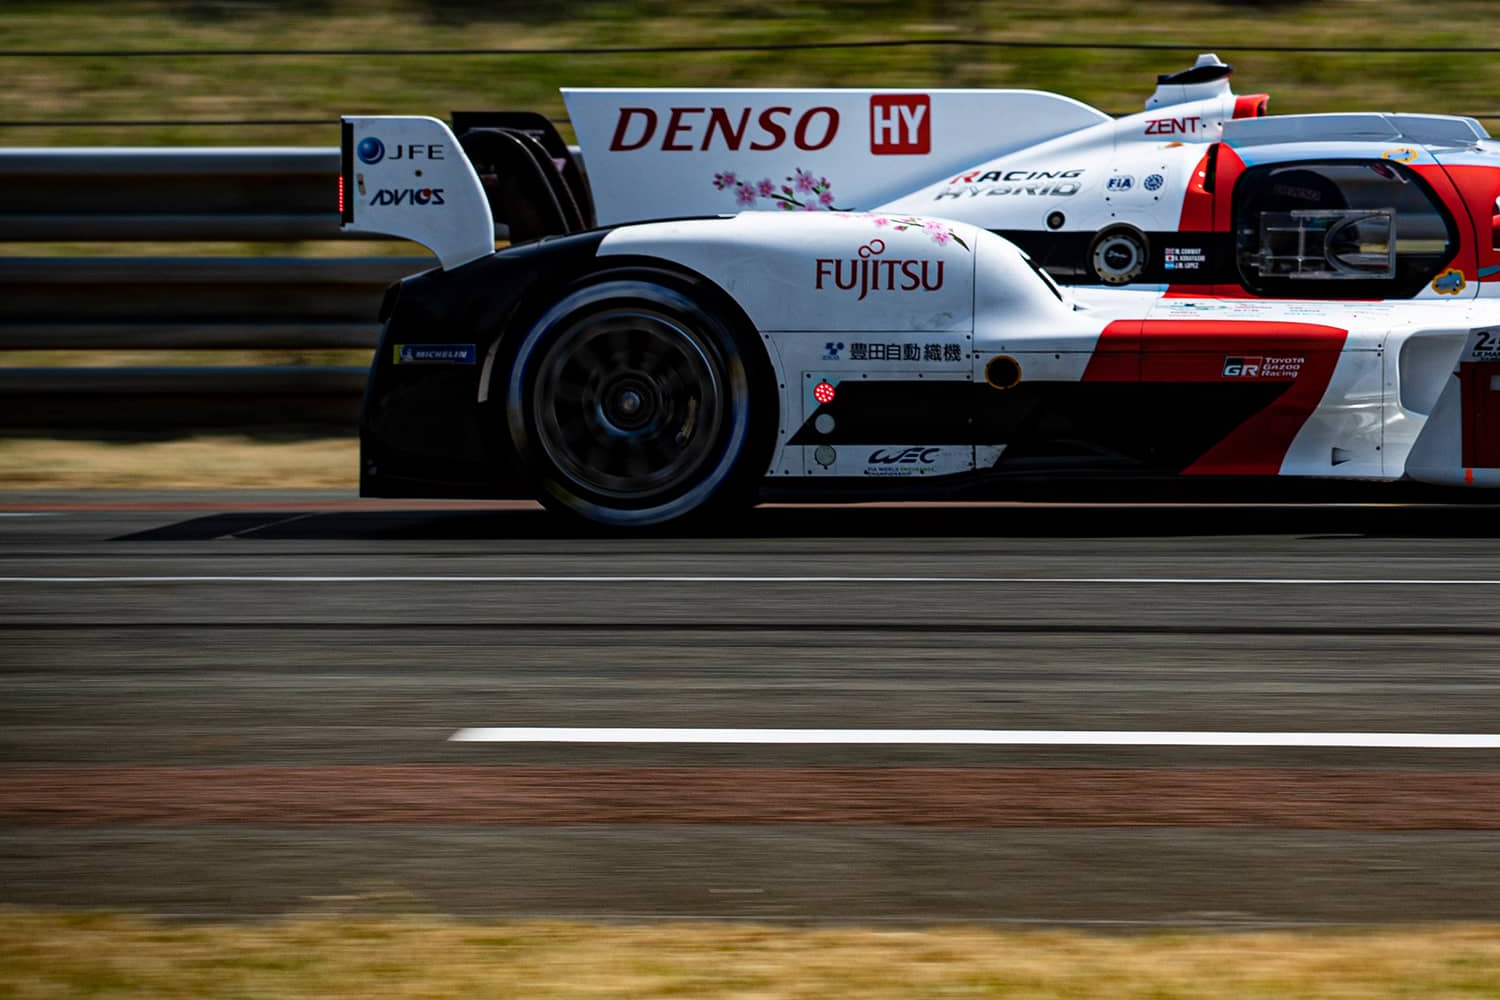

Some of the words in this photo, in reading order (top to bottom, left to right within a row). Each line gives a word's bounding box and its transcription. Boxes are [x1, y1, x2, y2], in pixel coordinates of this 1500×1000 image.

[608, 106, 840, 151] DENSO
[873, 105, 926, 145] HY
[1144, 116, 1201, 135] ZENT
[387, 144, 445, 160] JFE
[950, 169, 1085, 185] RACING
[369, 188, 446, 206] ADVICS
[935, 182, 1082, 201] HYBRID
[815, 239, 945, 301] FUJITSU
[415, 351, 468, 359] MICHELIN
[1224, 364, 1259, 377] GR
[1260, 370, 1298, 378] Racing
[868, 448, 940, 464] WEC
